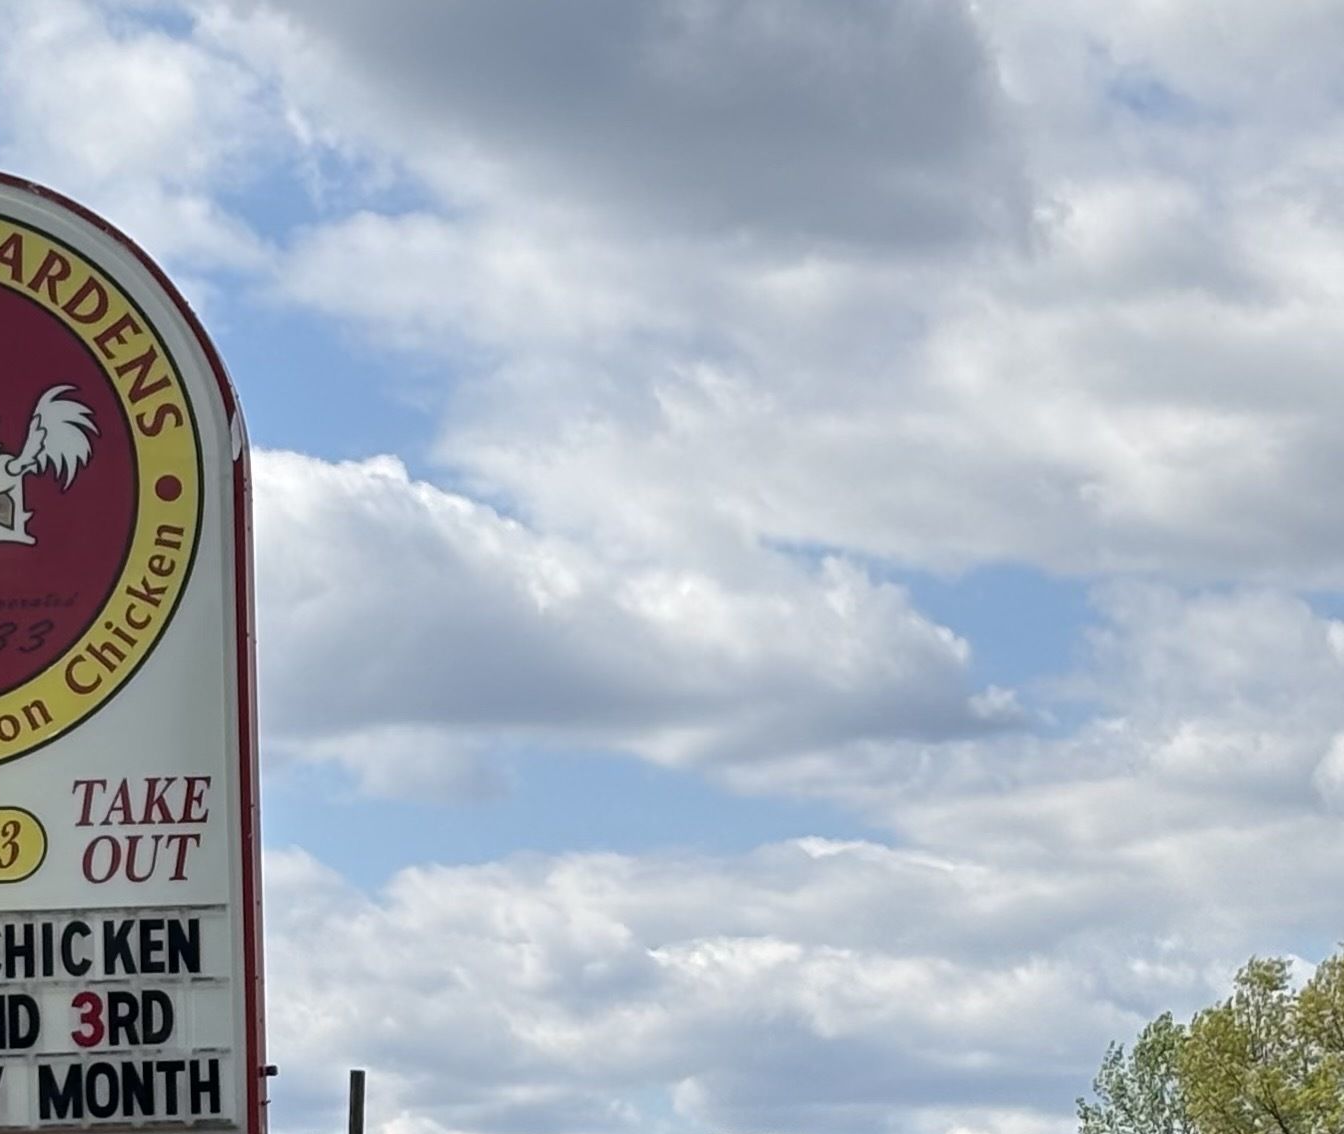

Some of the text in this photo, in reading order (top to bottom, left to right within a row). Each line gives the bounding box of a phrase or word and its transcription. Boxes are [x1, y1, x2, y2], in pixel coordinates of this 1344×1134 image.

[64, 523, 185, 696] Chicken
[71, 776, 212, 828] TAKE
[82, 833, 202, 884] OUT
[70, 990, 175, 1048] 3RD
[37, 1058, 221, 1121] MONTH
